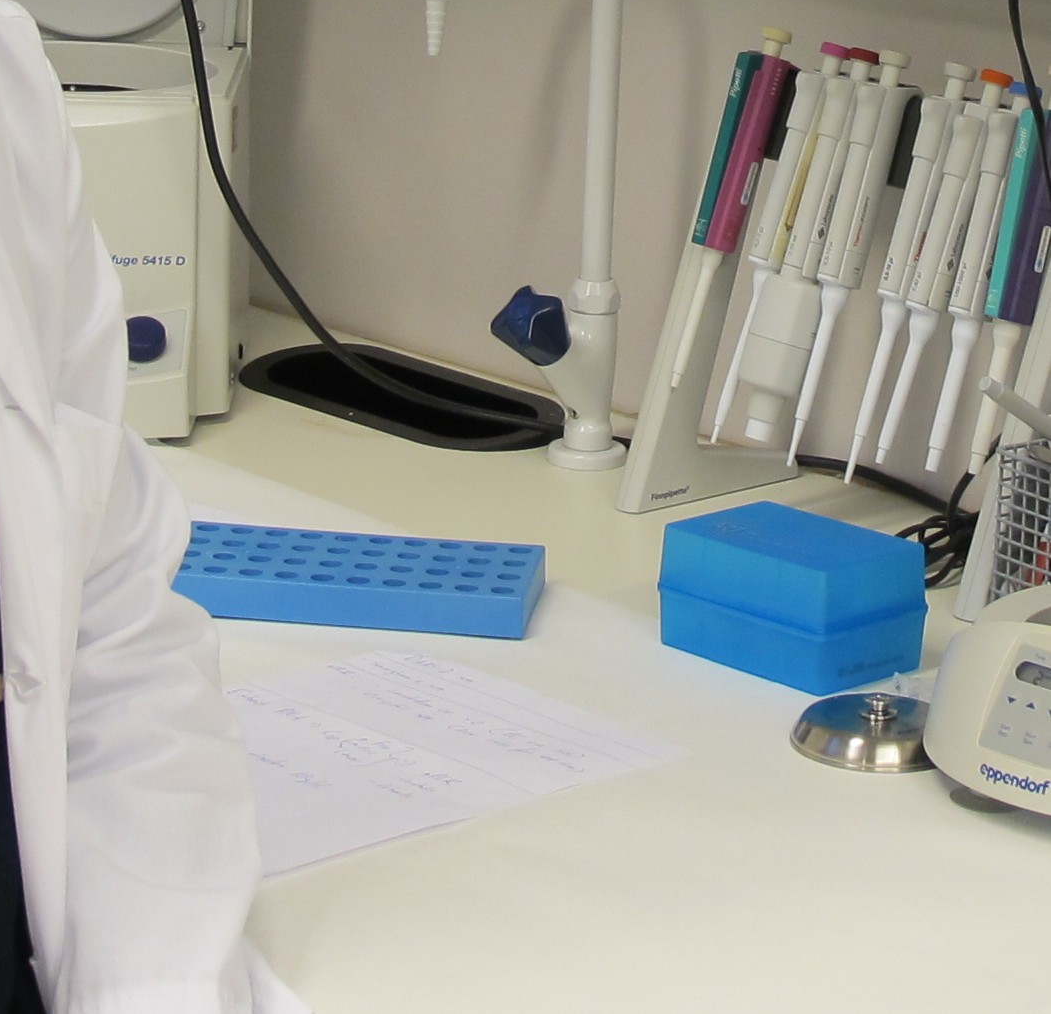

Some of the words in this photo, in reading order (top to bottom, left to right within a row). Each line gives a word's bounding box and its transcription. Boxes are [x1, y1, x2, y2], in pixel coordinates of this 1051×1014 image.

[141, 255, 172, 266] 5415
[175, 256, 186, 266] D
[980, 762, 1050, 796] eppendorf
